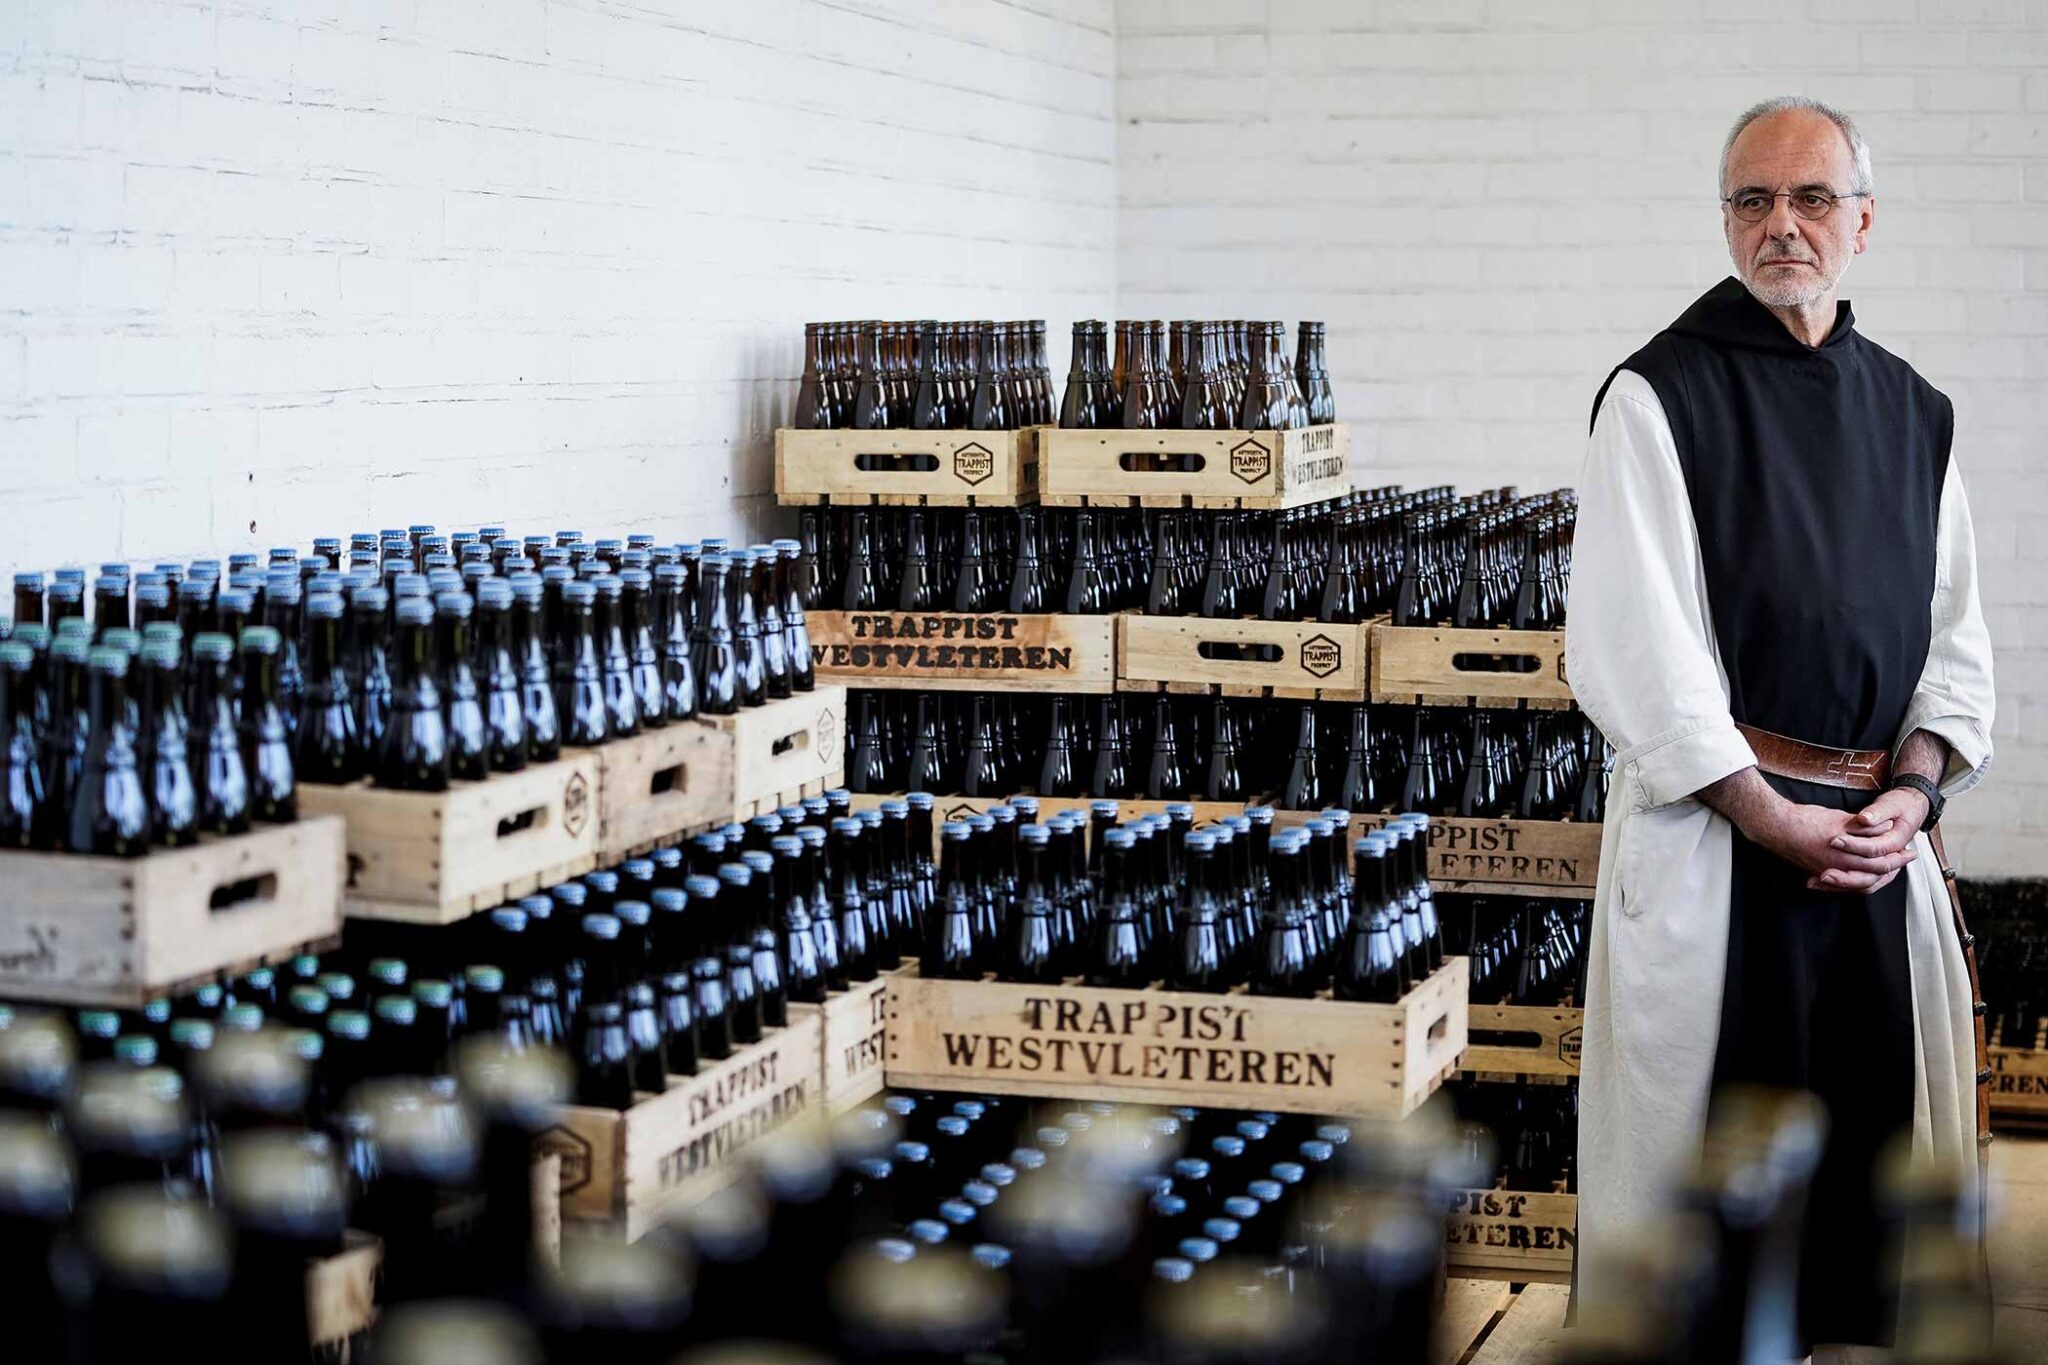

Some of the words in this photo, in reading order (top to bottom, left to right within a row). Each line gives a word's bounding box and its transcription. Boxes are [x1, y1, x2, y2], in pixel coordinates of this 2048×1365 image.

[1302, 428, 1333, 454] TRAPPIST
[956, 458, 990, 469] TRAPPIST
[1232, 456, 1267, 467] TRAPPIST
[1291, 455, 1343, 485] ESTVLETEREN
[852, 615, 1018, 640] TRAPPIST
[812, 644, 1072, 671] WESTVLETEREN
[1304, 651, 1337, 662] TRAPPIST
[1358, 821, 1520, 851] TPPIST
[1024, 998, 1253, 1043] TRAPPIST
[942, 1033, 1335, 1088] WESTVLETEREN
